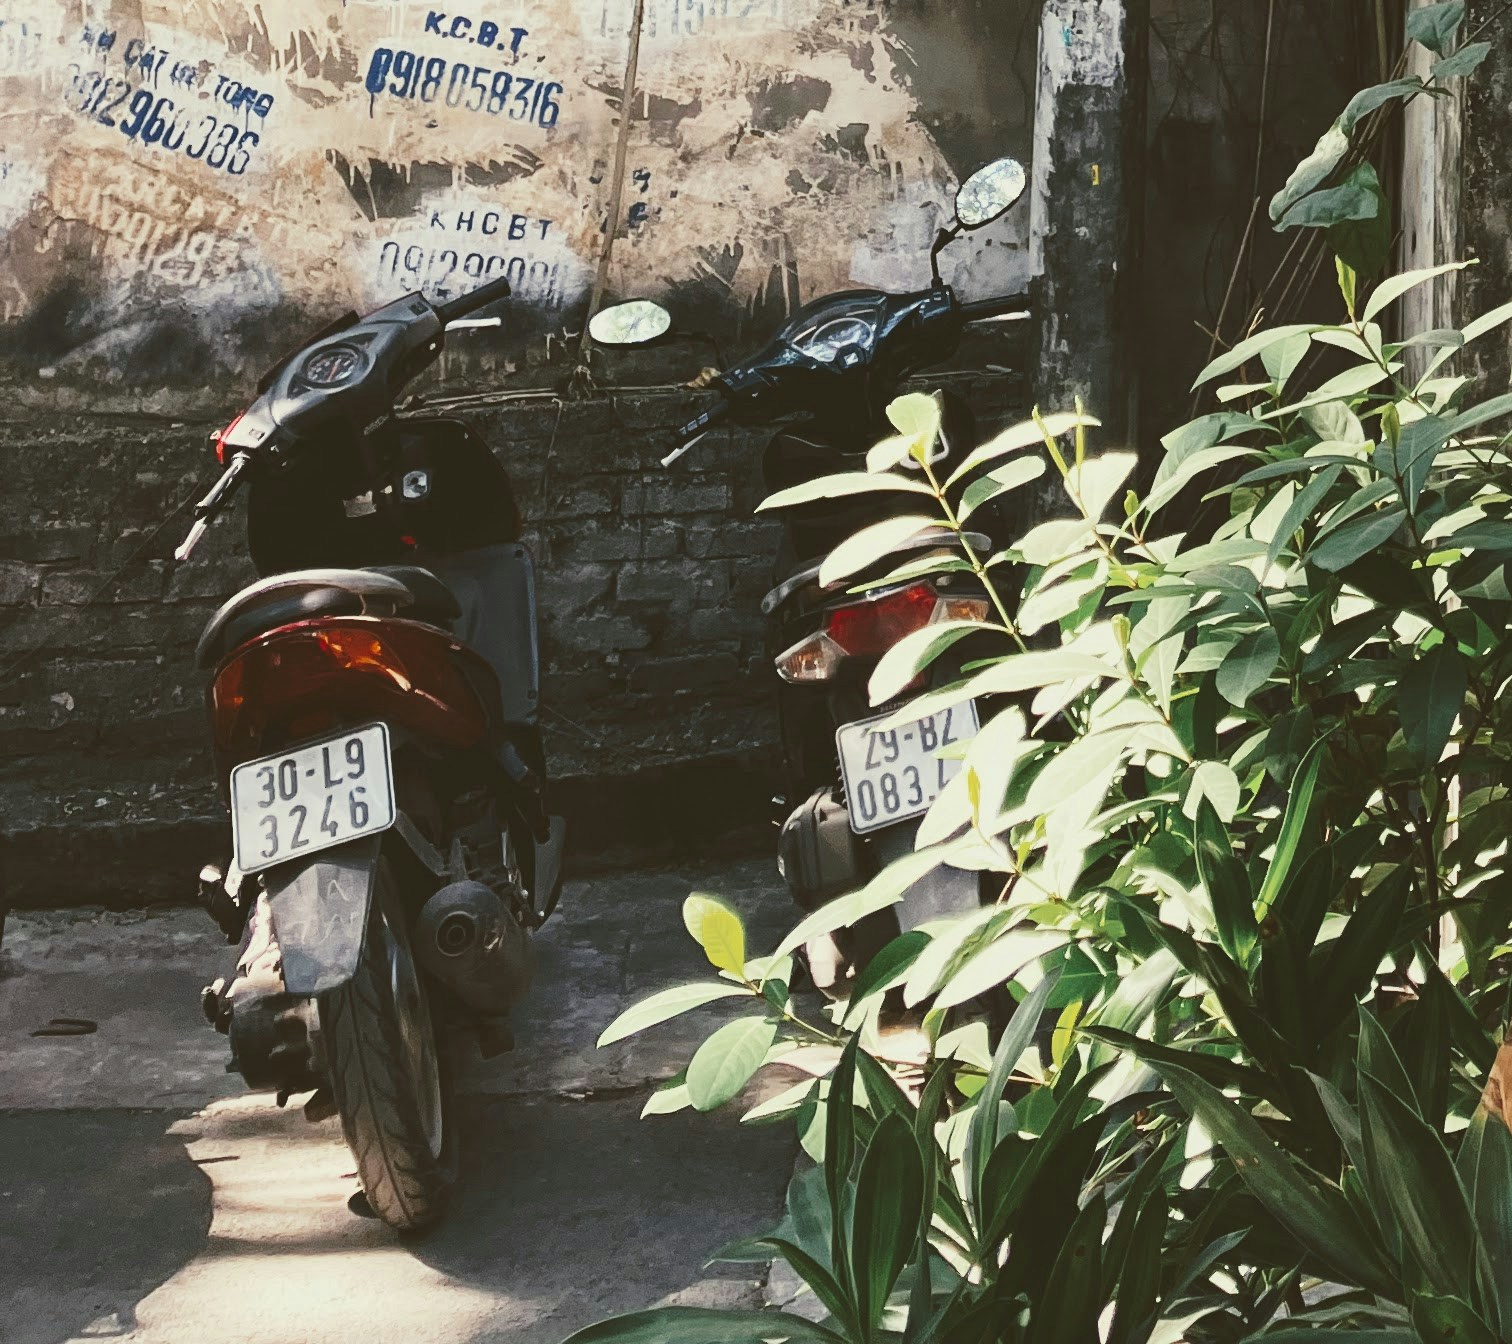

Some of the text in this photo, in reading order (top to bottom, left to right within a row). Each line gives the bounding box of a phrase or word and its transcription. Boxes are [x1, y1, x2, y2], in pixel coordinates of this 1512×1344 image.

[365, 47, 564, 129] 0918058316
[256, 737, 365, 809] 30-L9
[259, 786, 369, 859] 3246
